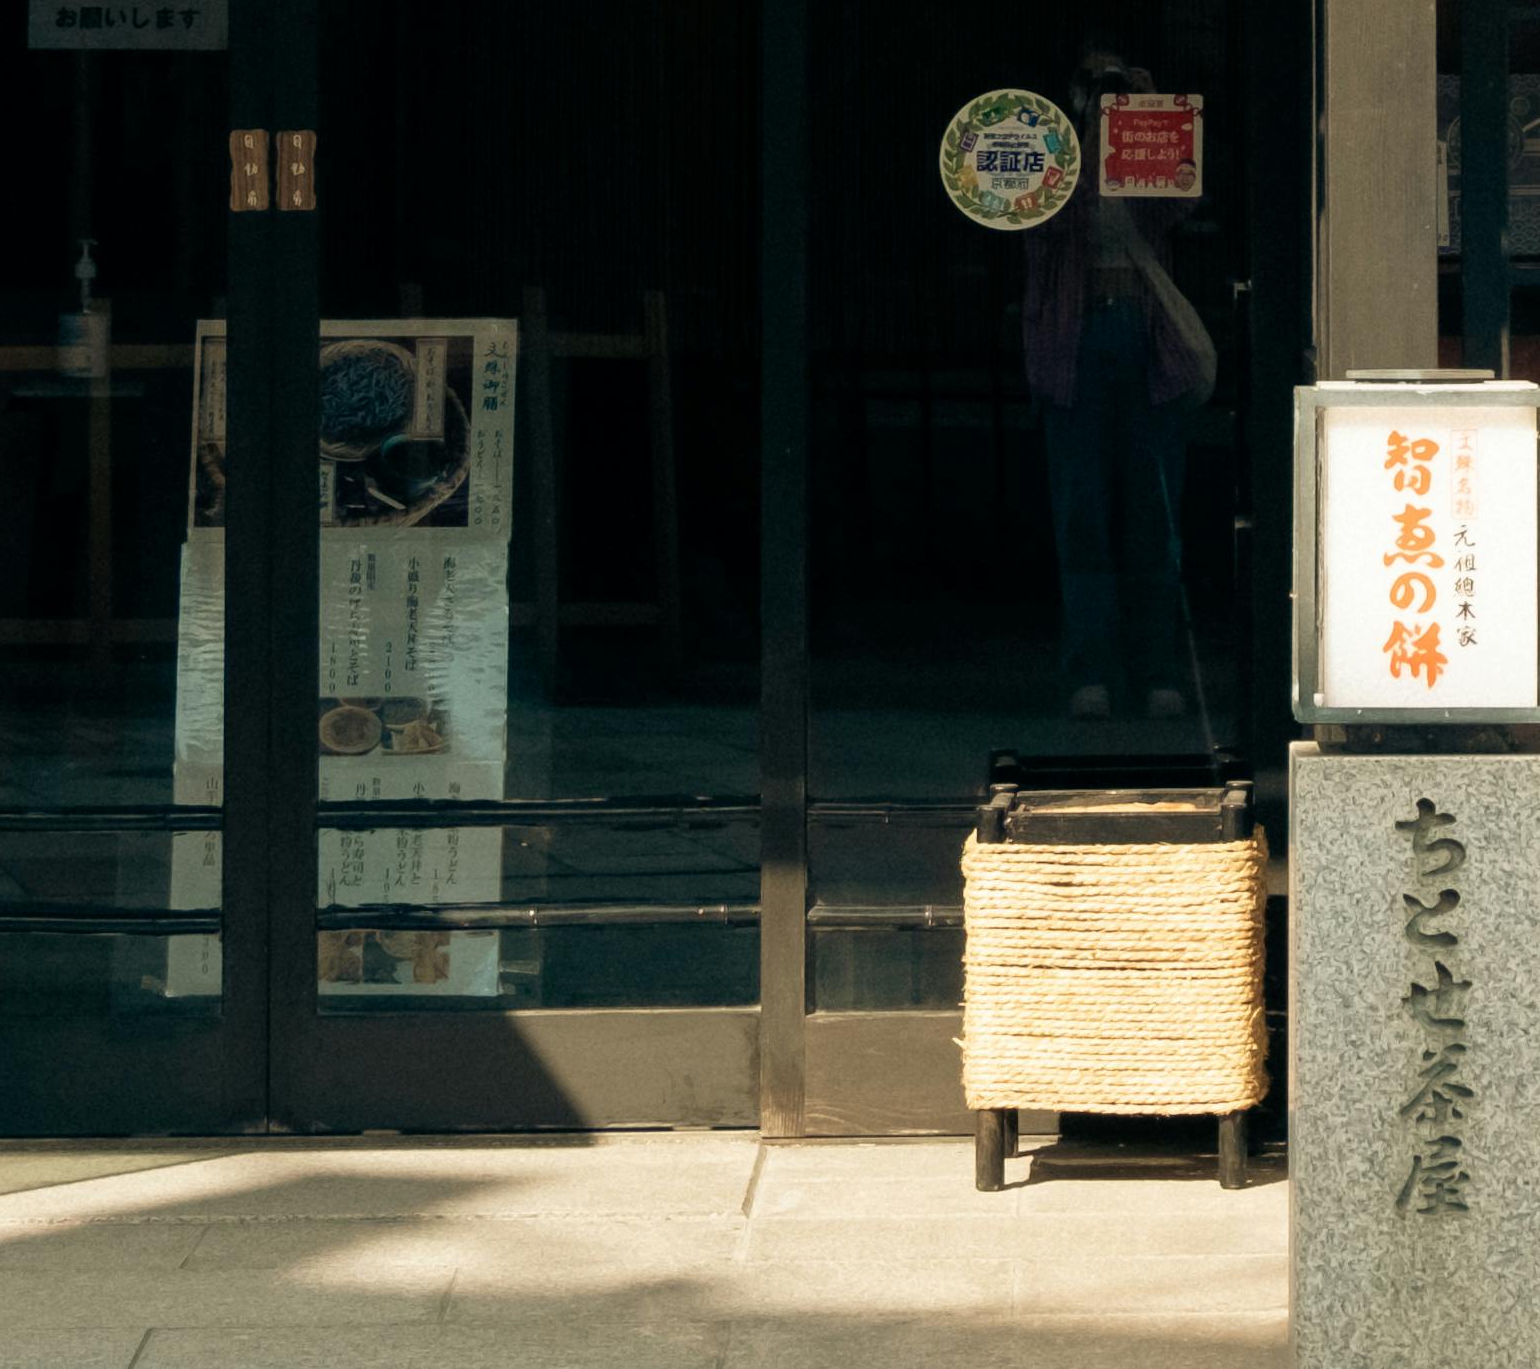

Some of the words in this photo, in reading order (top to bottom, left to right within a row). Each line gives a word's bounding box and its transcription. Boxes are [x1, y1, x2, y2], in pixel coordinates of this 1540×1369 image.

[54, 6, 202, 30] お願いします
[1121, 129, 1180, 143] 街のお店を
[976, 150, 1045, 172] 認証店
[1395, 797, 1474, 1217] ちとせ茶屋
